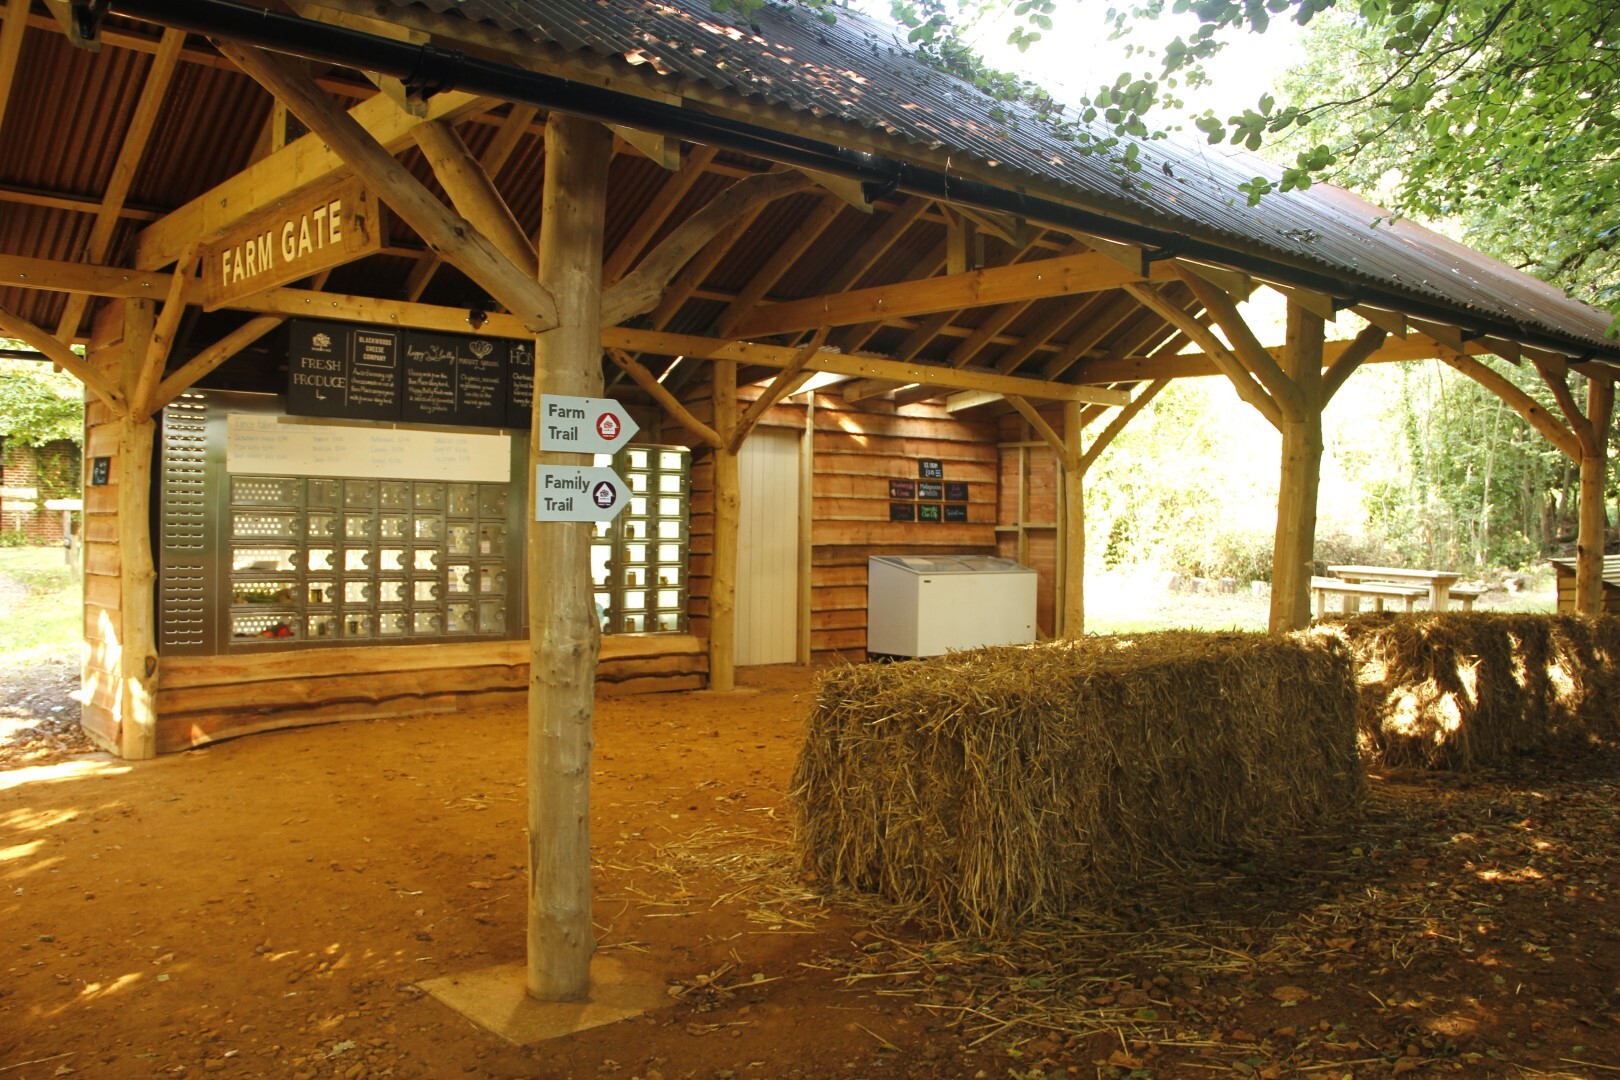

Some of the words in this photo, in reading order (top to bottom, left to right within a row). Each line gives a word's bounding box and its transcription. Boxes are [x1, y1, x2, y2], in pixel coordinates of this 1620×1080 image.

[222, 231, 273, 287] FARM
[281, 200, 342, 262] GATE
[359, 336, 392, 346] BLACKWOODS
[301, 357, 341, 371] FRESH
[363, 354, 387, 362] COMPANY
[293, 373, 347, 388] PRODUCE
[548, 404, 585, 419] Farm
[548, 426, 578, 440] Trail
[545, 474, 591, 494] Family
[544, 497, 573, 511] Trail
